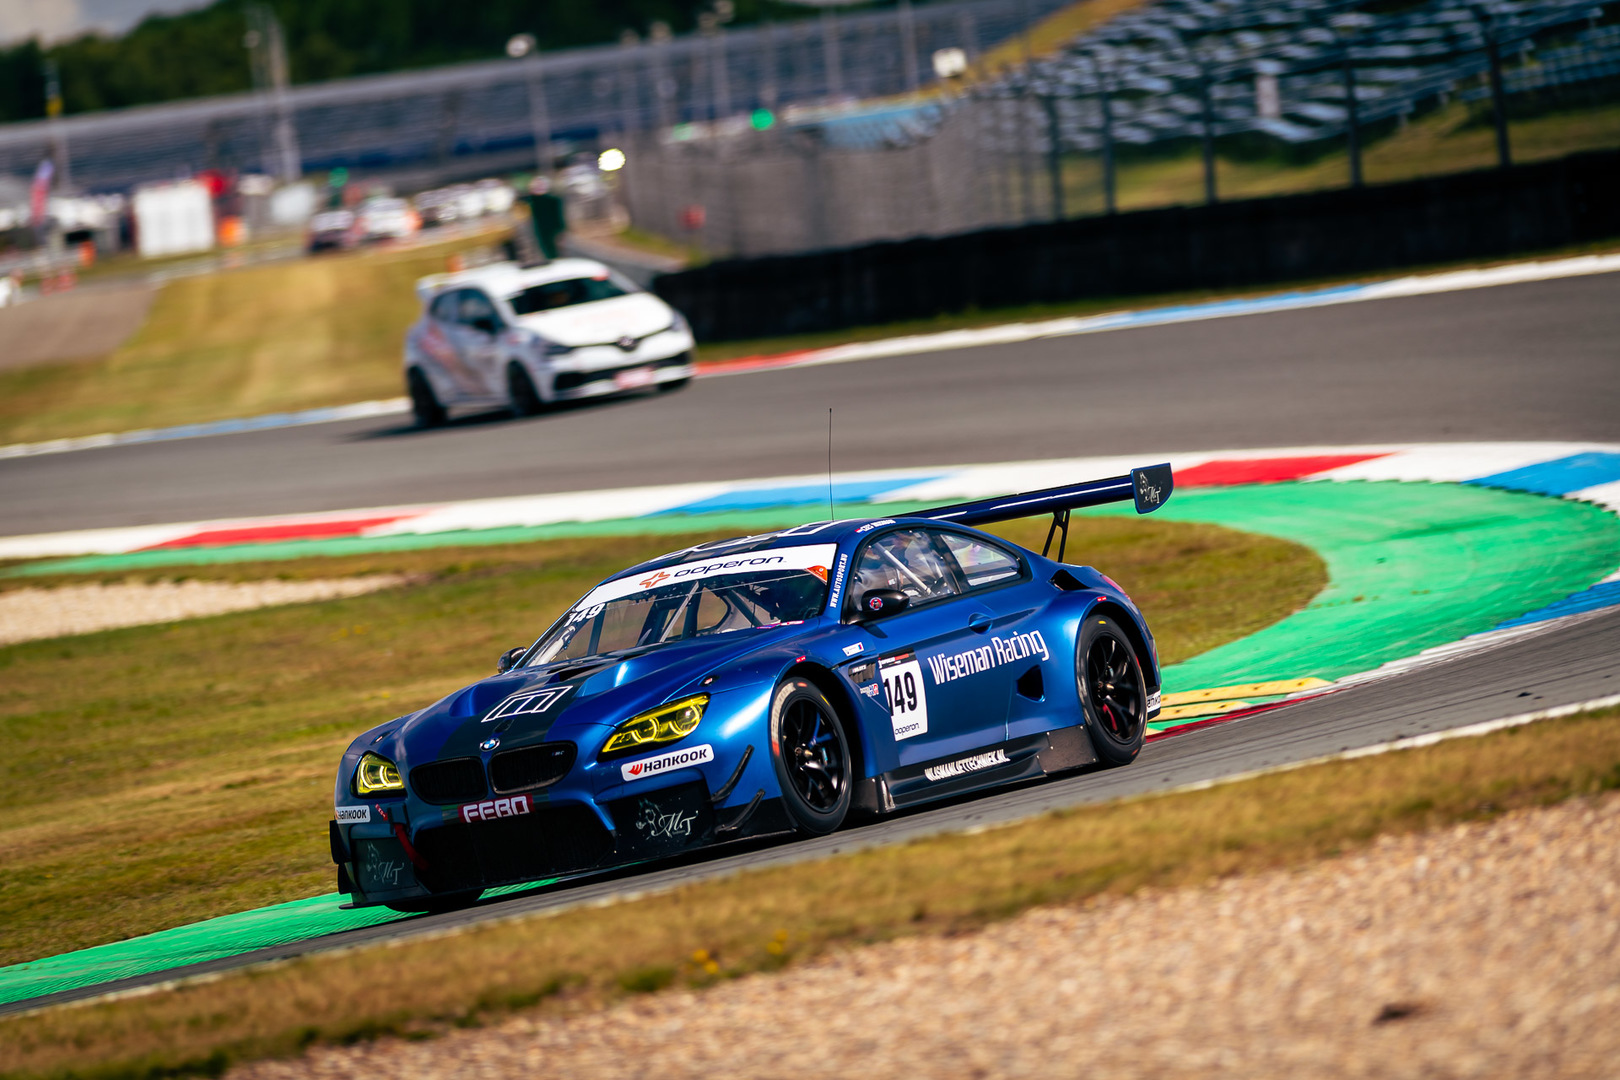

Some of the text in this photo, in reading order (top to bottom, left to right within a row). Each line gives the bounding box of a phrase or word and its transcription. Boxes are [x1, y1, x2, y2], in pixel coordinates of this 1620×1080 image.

[563, 603, 605, 628] 149
[928, 653, 996, 685] Wiseman
[991, 630, 1050, 661] Racing
[884, 671, 917, 716] 149
[463, 796, 530, 823] FEBO
